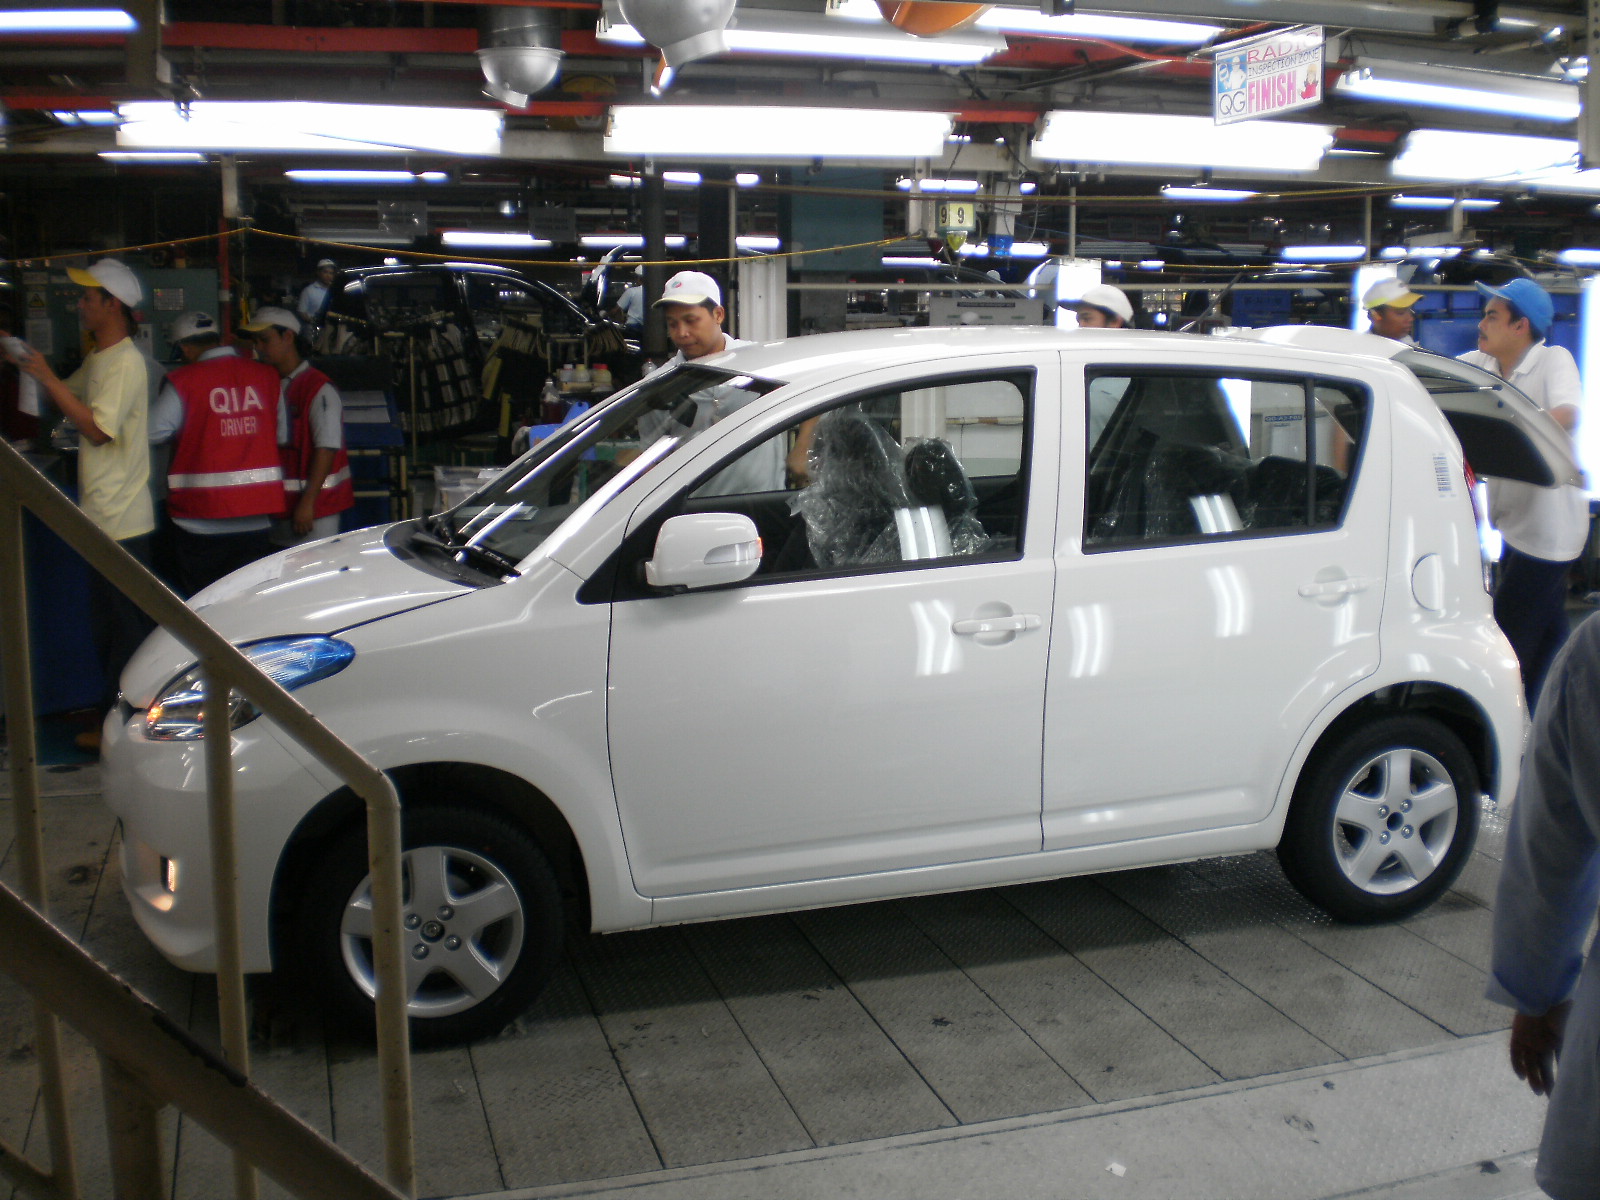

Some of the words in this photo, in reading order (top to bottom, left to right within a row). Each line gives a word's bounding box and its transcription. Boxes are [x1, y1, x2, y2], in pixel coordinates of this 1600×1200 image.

[1248, 53, 1297, 77] INSPECTION
[1298, 47, 1320, 63] ZONE
[1220, 91, 1246, 115] QG
[1248, 70, 1297, 114] FINISH
[941, 206, 948, 224] 9
[957, 207, 965, 224] 9
[209, 386, 263, 414] QIA
[220, 416, 257, 436] DRIVER
